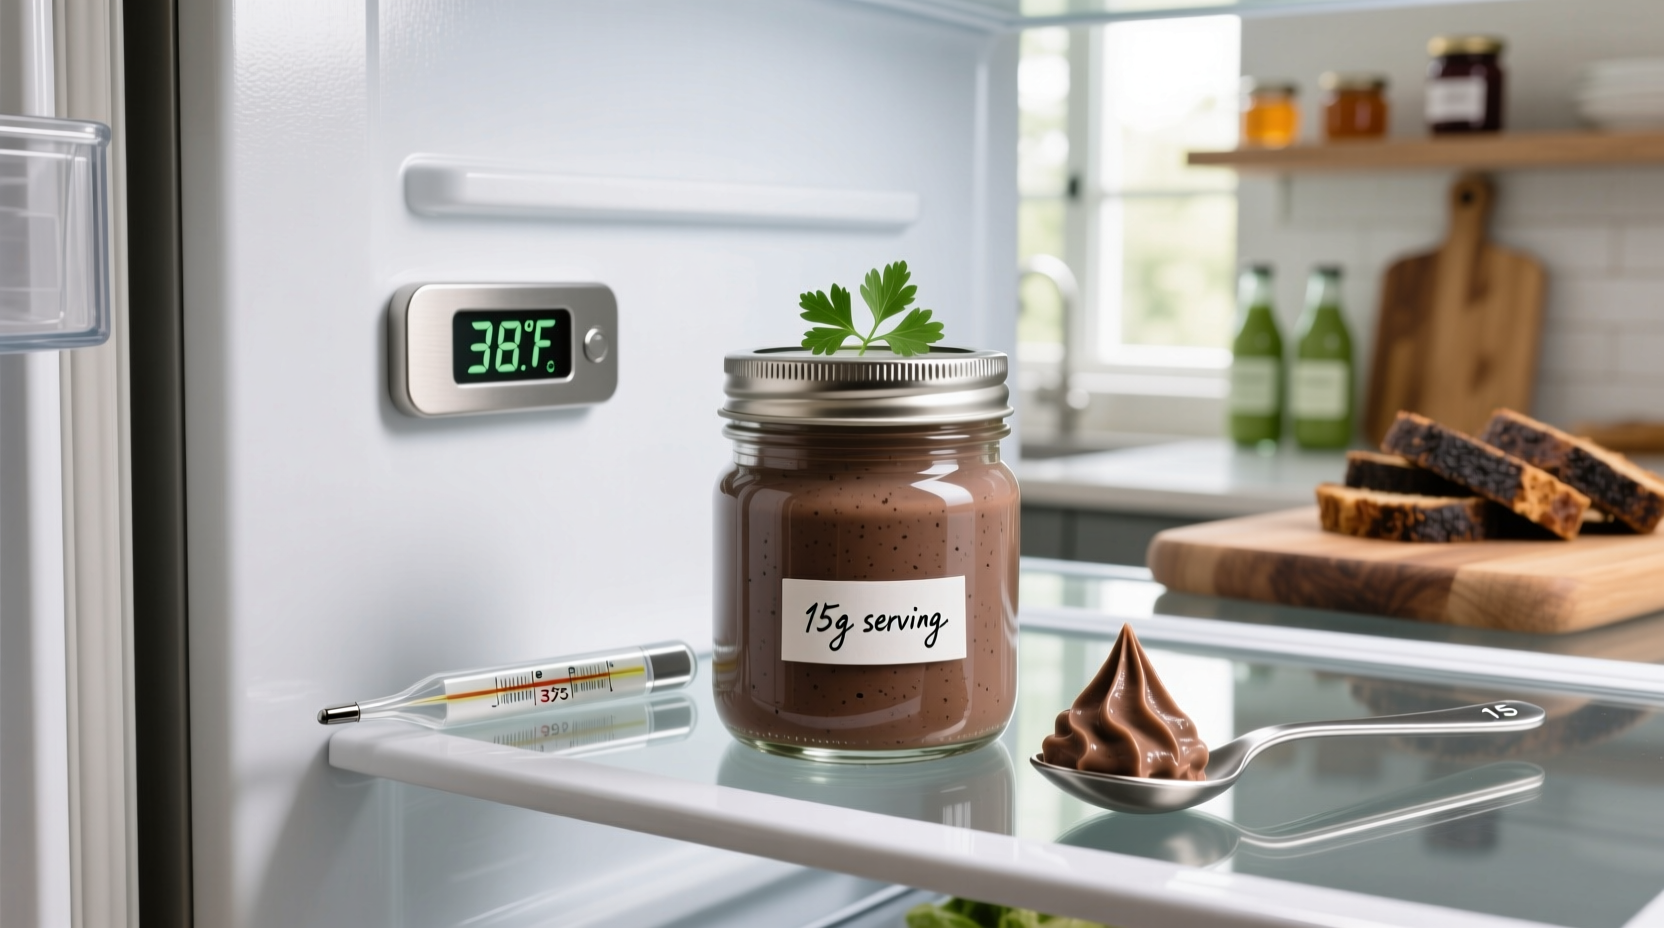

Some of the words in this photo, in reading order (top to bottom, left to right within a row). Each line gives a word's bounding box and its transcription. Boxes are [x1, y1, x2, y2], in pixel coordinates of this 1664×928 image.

[805, 602, 854, 651] 15g
[863, 606, 949, 648] serving
[1481, 704, 1518, 719] 15
